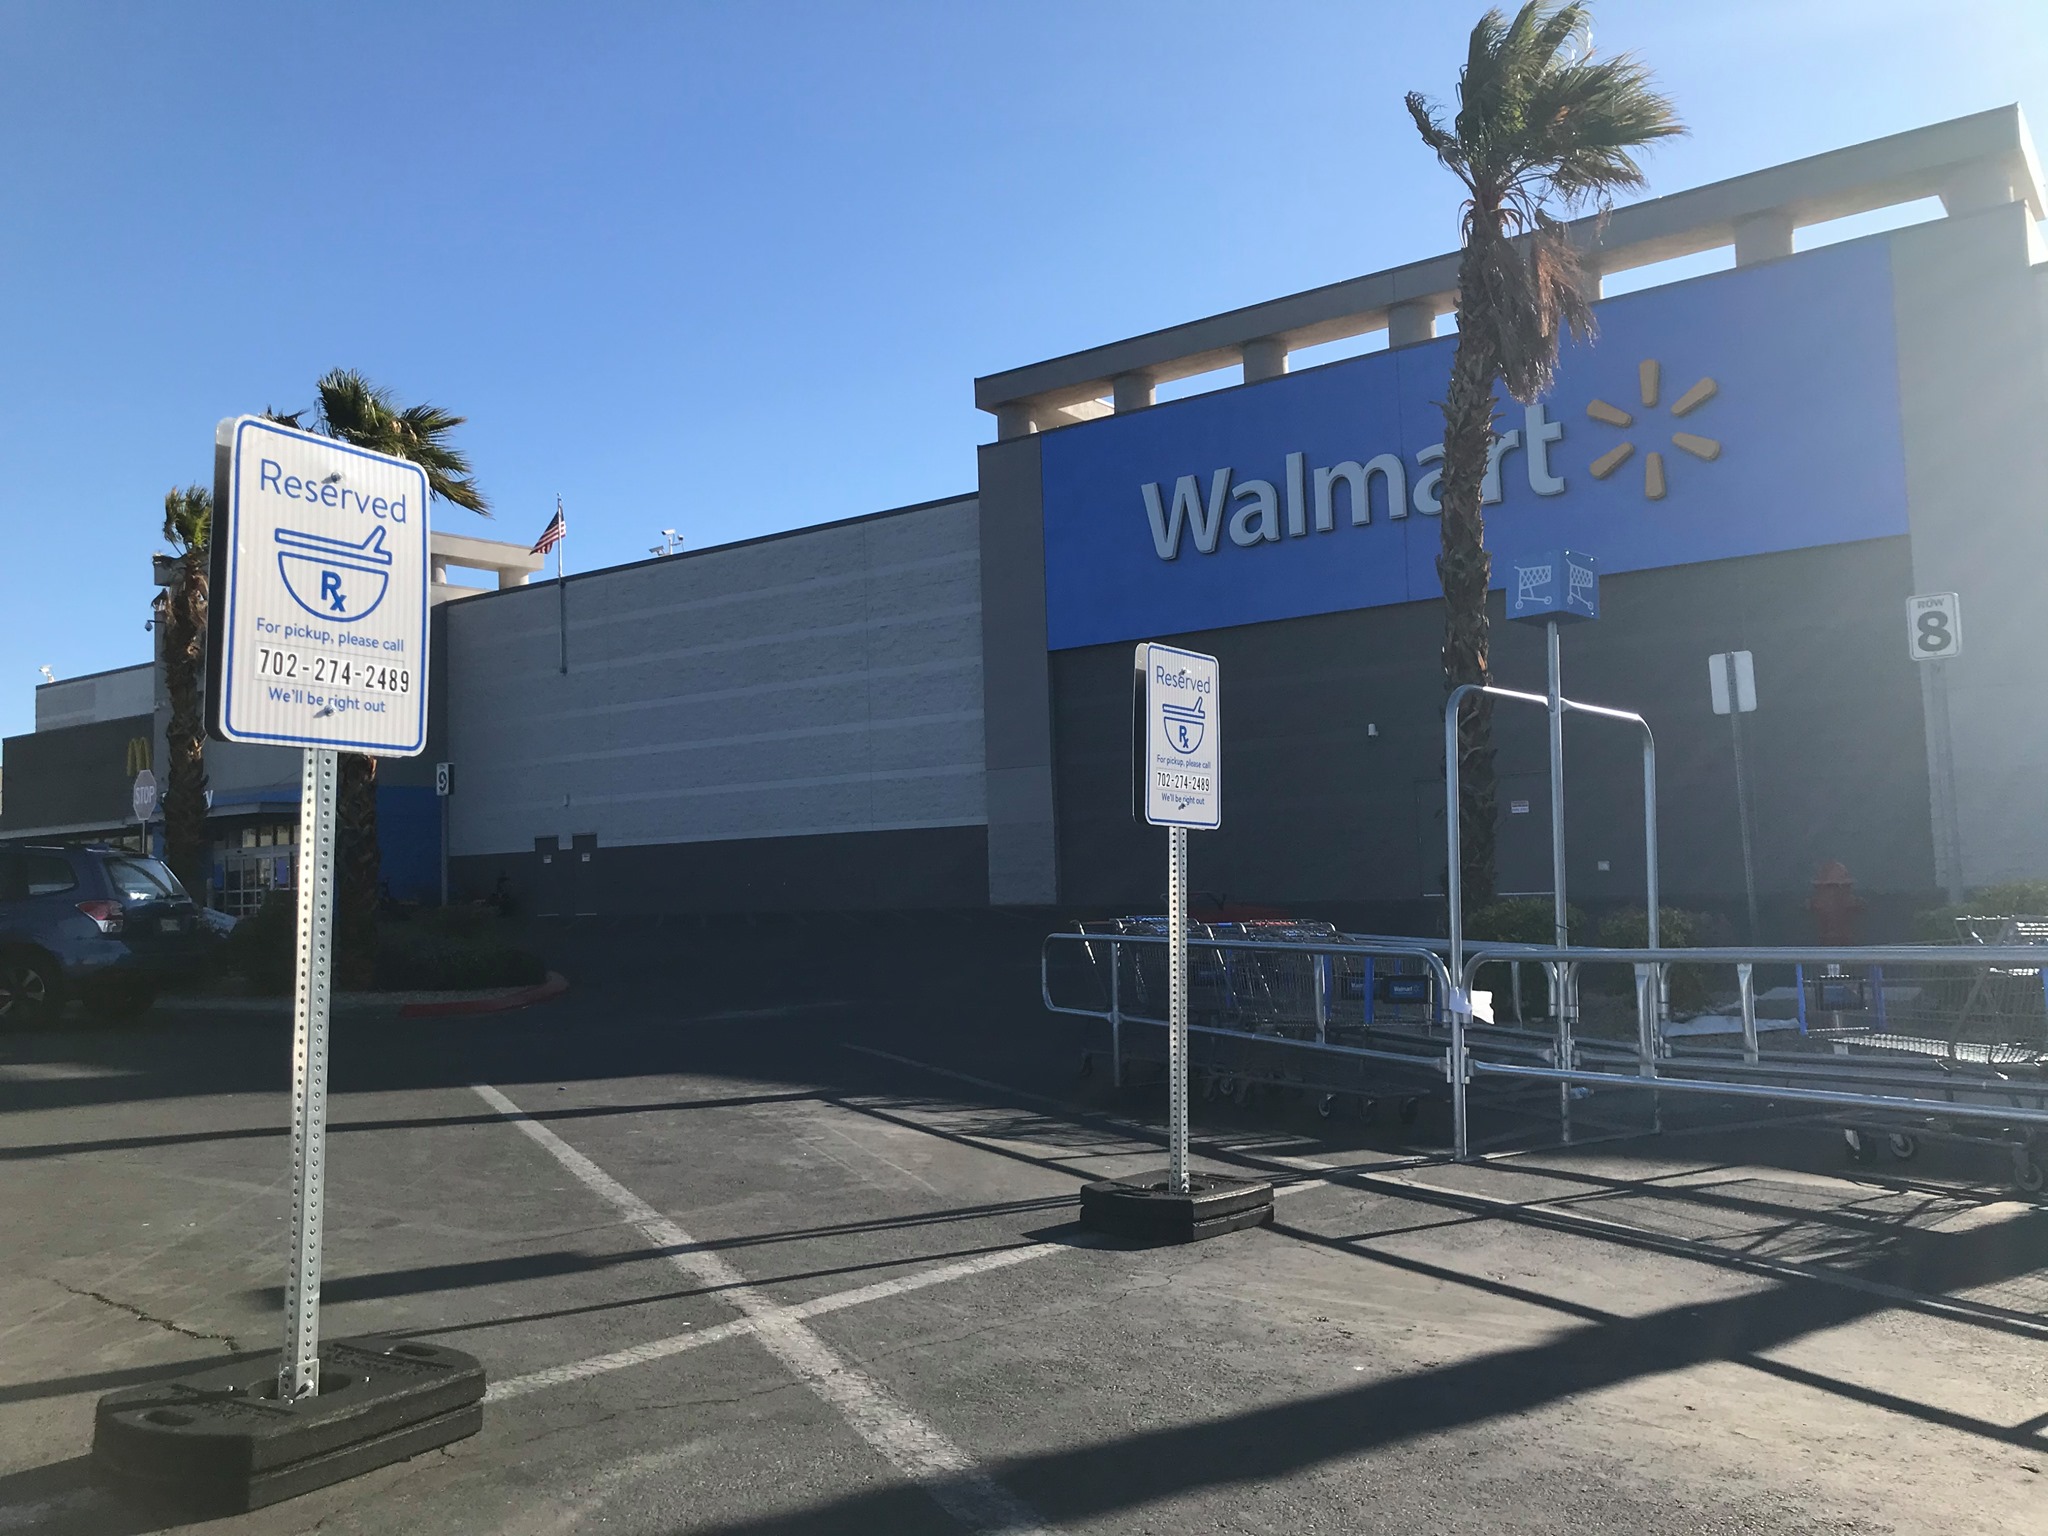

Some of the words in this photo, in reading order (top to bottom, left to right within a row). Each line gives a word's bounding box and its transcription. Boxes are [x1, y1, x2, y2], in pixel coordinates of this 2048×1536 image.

[260, 458, 407, 524] Reserved
[321, 570, 347, 612] Rx
[1917, 598, 1945, 609] ROW
[256, 617, 281, 634] For
[284, 623, 334, 645] pickup,
[338, 631, 379, 649] please
[382, 639, 404, 652] call
[1917, 610, 1952, 652] 8
[260, 648, 410, 693] 702-274-2489
[1156, 665, 1211, 694] Reserved
[268, 686, 303, 704] We'll
[307, 692, 324, 706] be
[328, 694, 360, 712] right
[364, 700, 386, 713] out
[1156, 754, 1166, 763] For
[1186, 759, 1201, 768] please
[1202, 761, 1211, 769] call
[438, 770, 448, 792] 9
[1157, 772, 1210, 792] 702-274-2489
[135, 785, 155, 805] STOP
[1161, 792, 1175, 802] We'll
[1175, 794, 1182, 803] be
[1182, 796, 1196, 806] right
